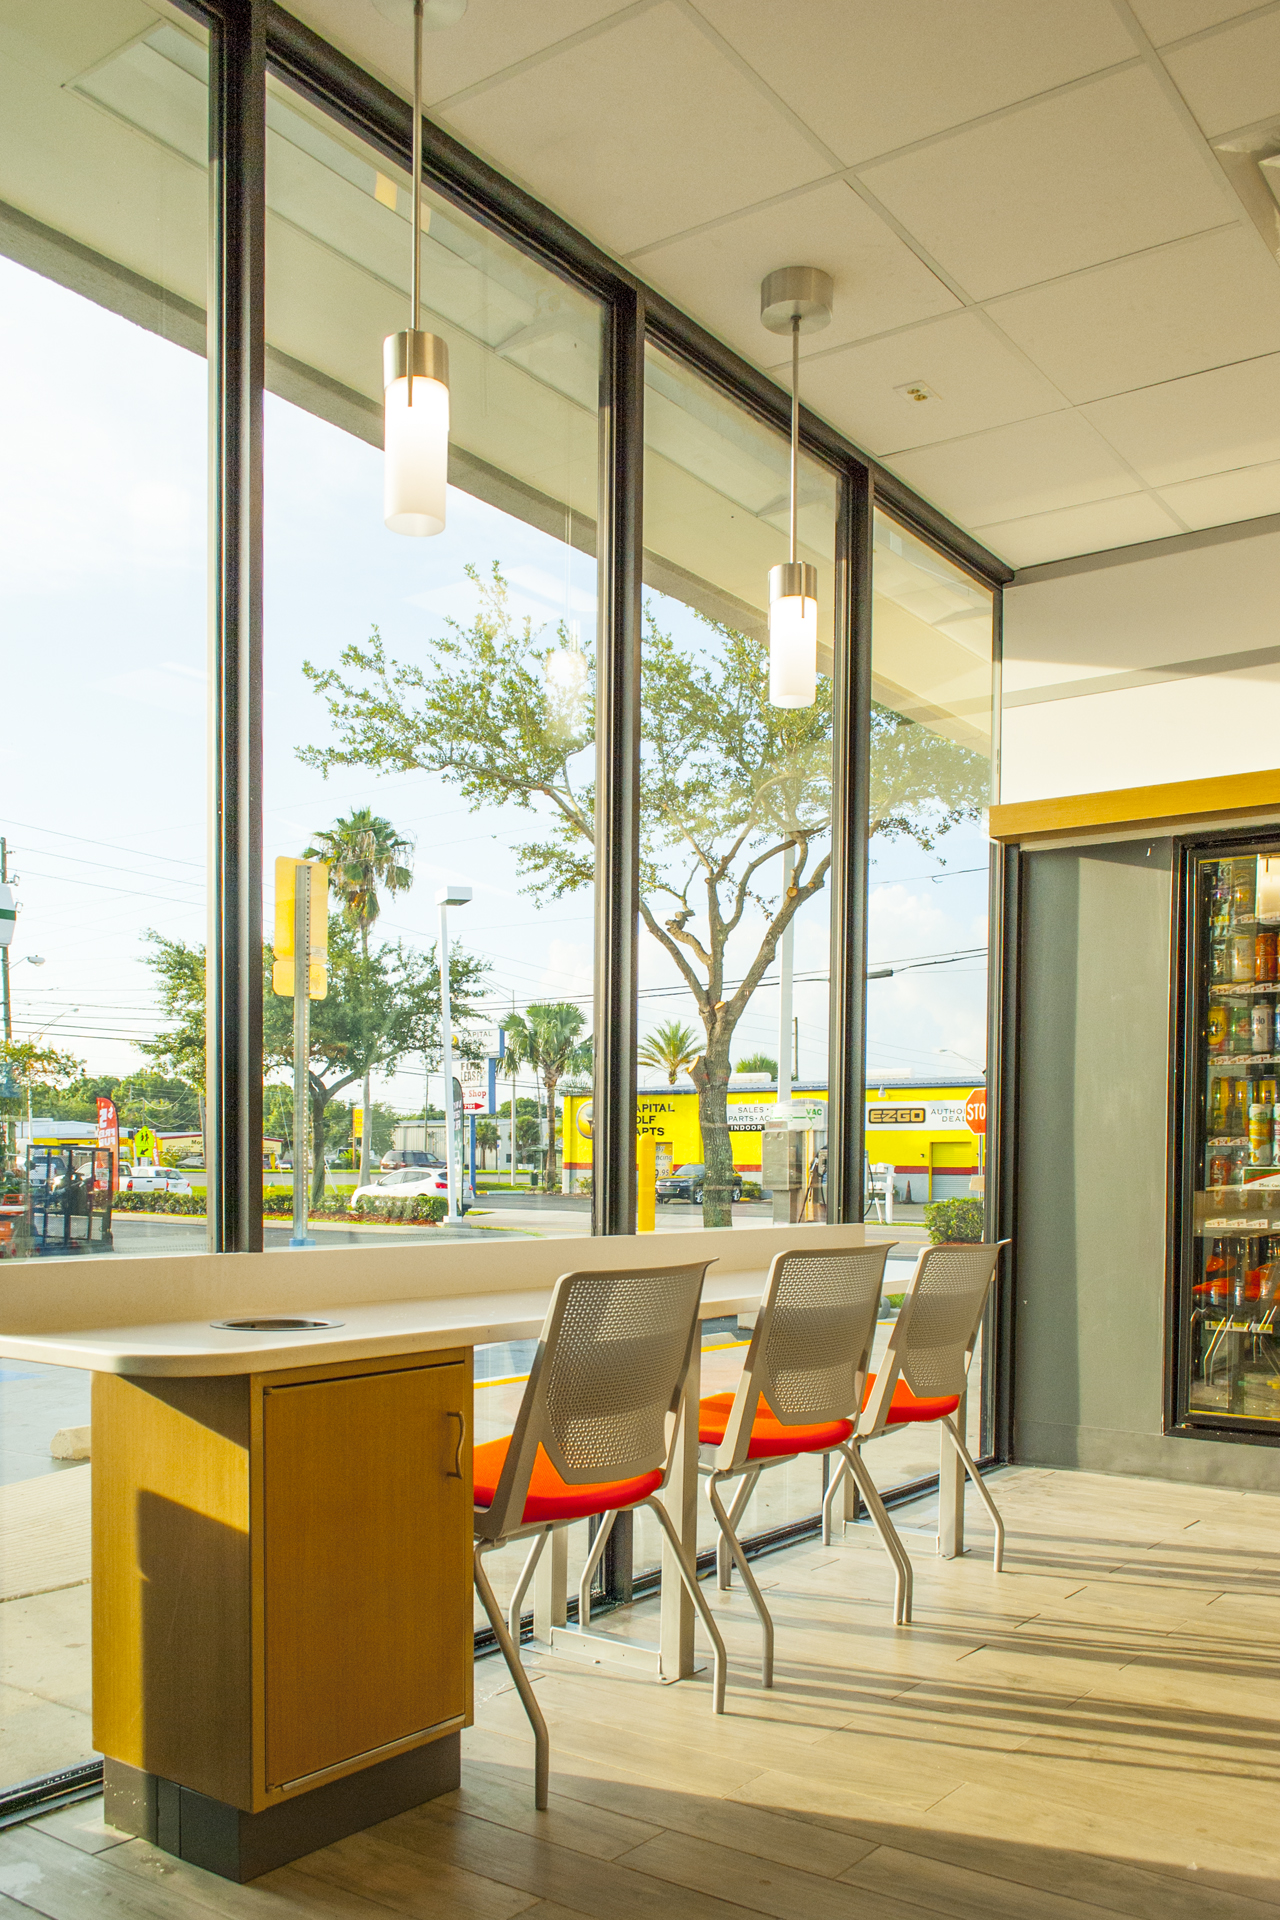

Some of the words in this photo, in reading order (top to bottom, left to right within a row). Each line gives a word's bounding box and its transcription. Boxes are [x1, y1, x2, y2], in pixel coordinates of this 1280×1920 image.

[469, 1090, 487, 1099] Shop
[636, 1103, 676, 1113] APITAL
[805, 1108, 823, 1116] VAC
[966, 1103, 986, 1120] STO
[636, 1115, 657, 1125] OLF
